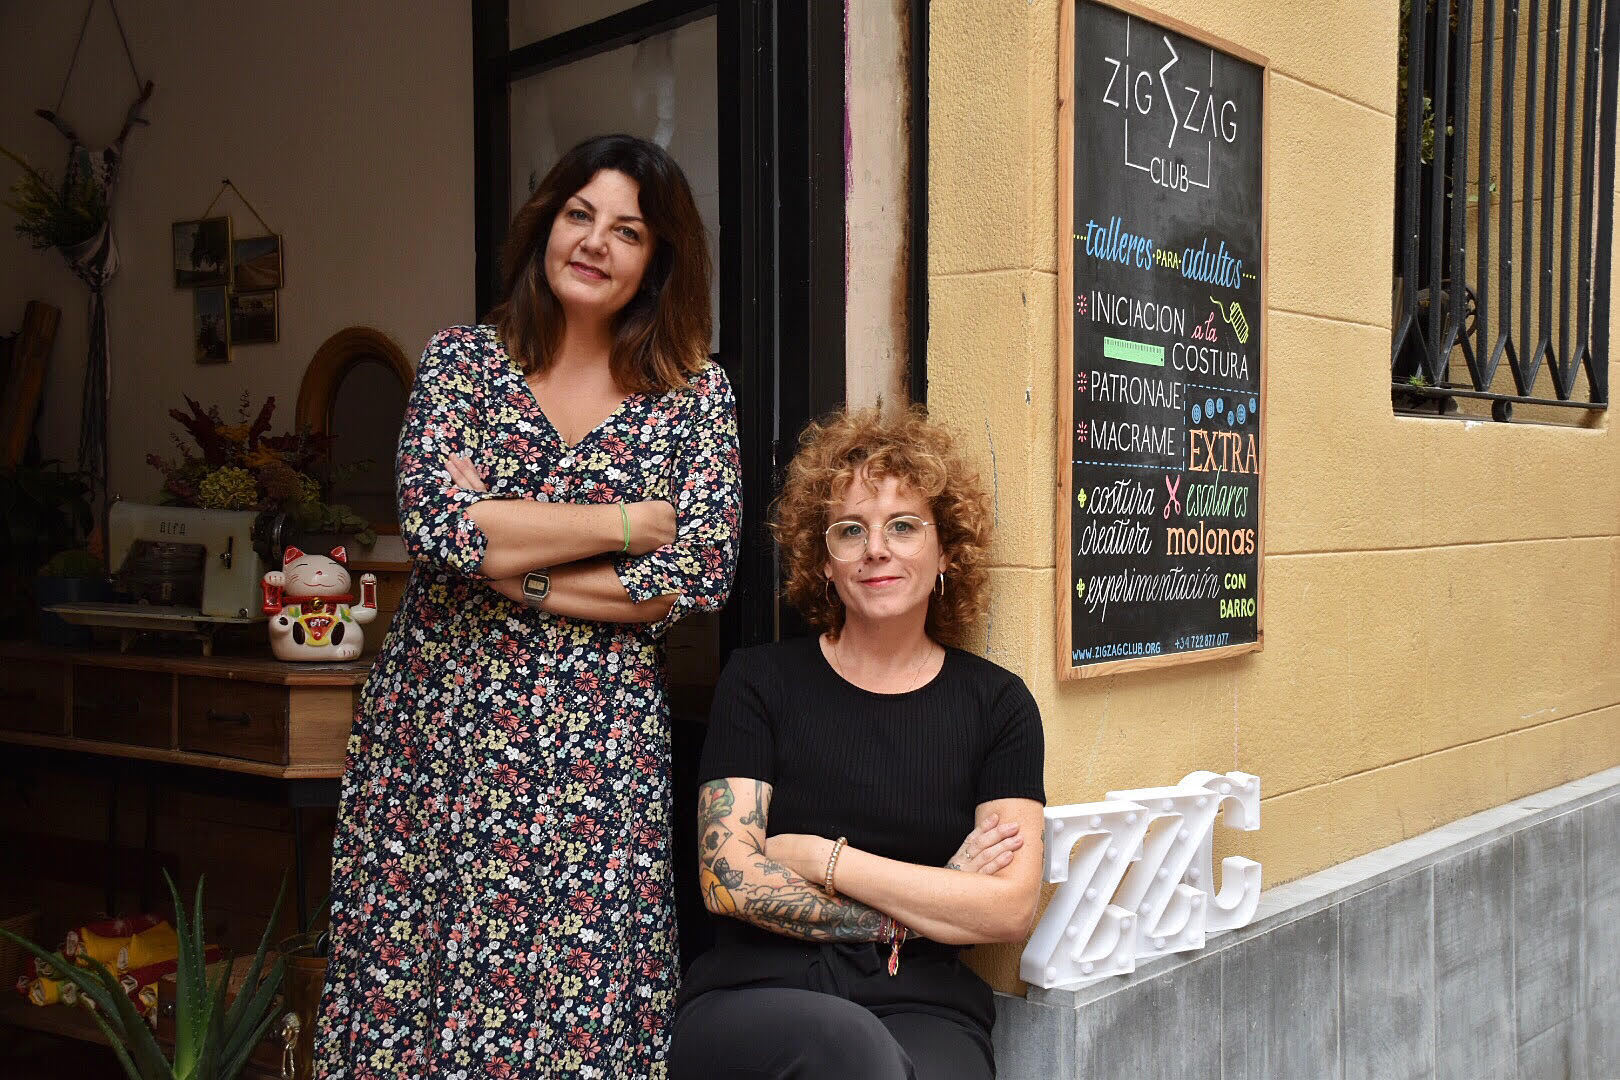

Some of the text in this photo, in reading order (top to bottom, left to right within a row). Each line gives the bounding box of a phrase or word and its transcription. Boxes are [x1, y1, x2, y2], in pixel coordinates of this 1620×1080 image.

[1103, 56, 1152, 115] ZIG
[1150, 156, 1189, 193] CLUB
[1086, 215, 1243, 289] talleres PARA adultos
[1091, 290, 1185, 337] INICIACION
[1172, 342, 1249, 381] COSTURA
[1091, 370, 1182, 410] PATRONAJE
[1091, 419, 1175, 456] MACRAME
[1188, 428, 1259, 475] EXTRA
[1086, 478, 1156, 516] costura
[1186, 465, 1249, 519] escolares
[1077, 518, 1153, 556] creativa
[1166, 520, 1256, 556] molonas
[1084, 566, 1247, 623] experimentación CON
[1219, 598, 1256, 619] BARRO
[1072, 642, 1161, 661] WWW.ZIGZAGCLUB.ORG
